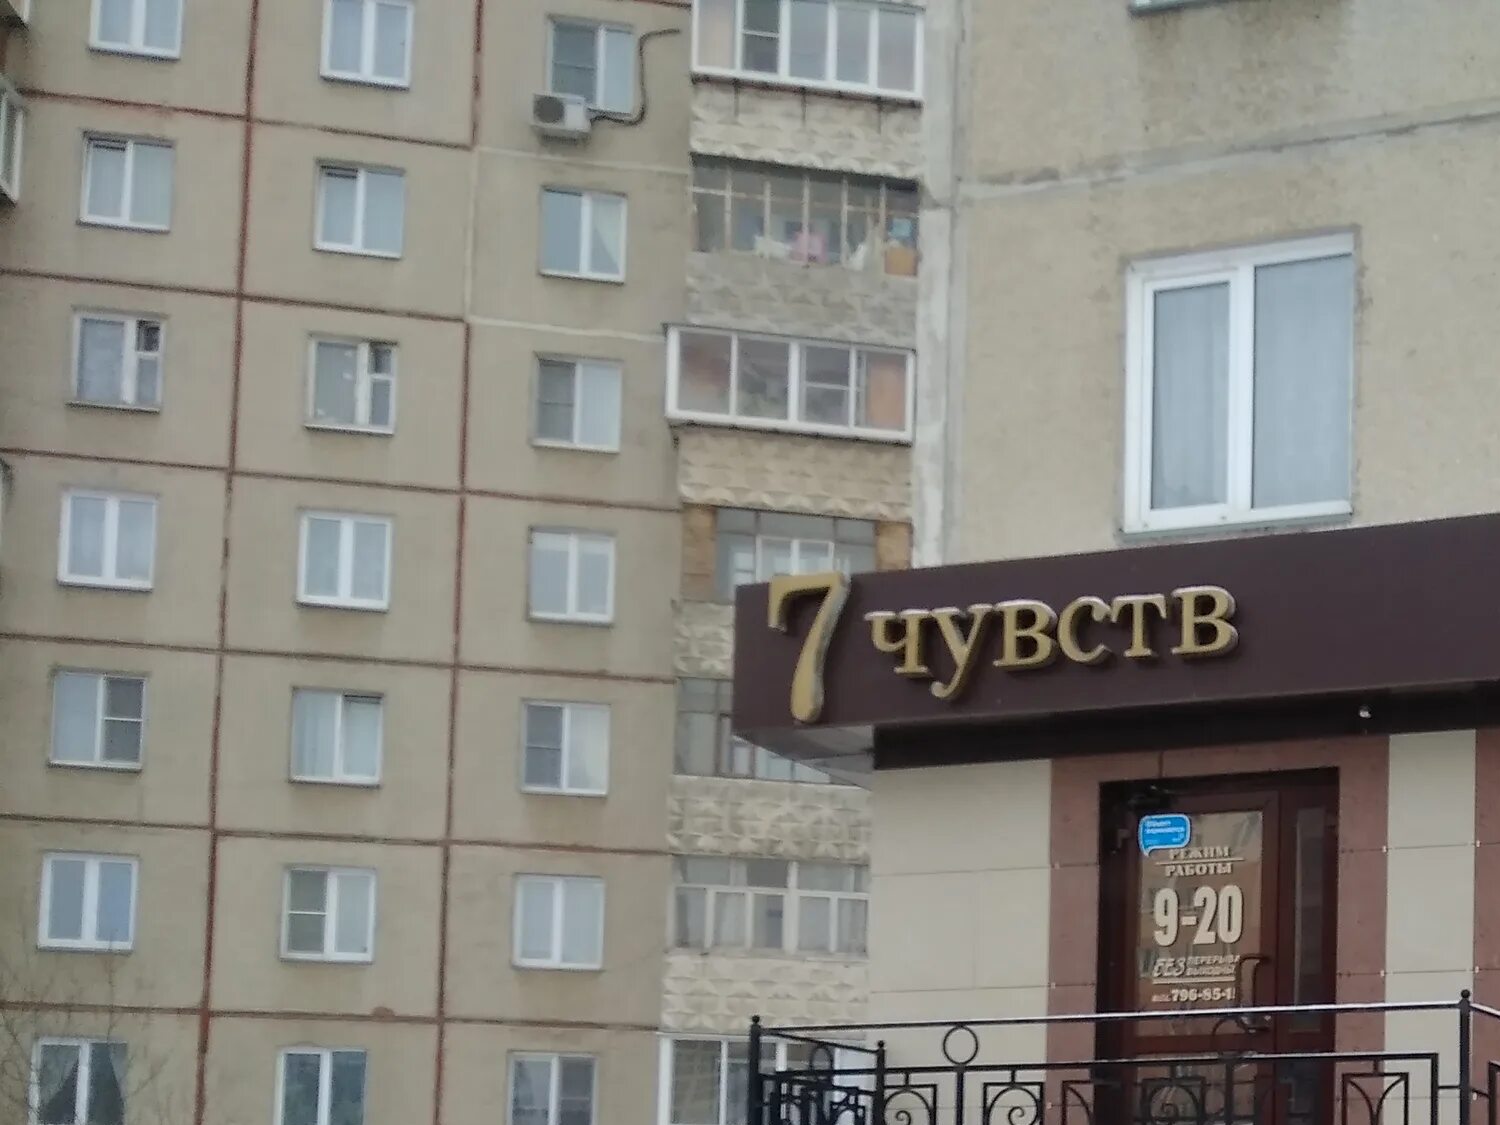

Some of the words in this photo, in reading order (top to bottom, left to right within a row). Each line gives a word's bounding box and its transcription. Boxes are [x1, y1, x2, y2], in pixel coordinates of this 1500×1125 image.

[768, 570, 850, 724] 7
[1165, 862, 1232, 877] РАБОТЫ
[1168, 846, 1231, 860] РЕЖИМ
[1153, 884, 1244, 946] 9-20
